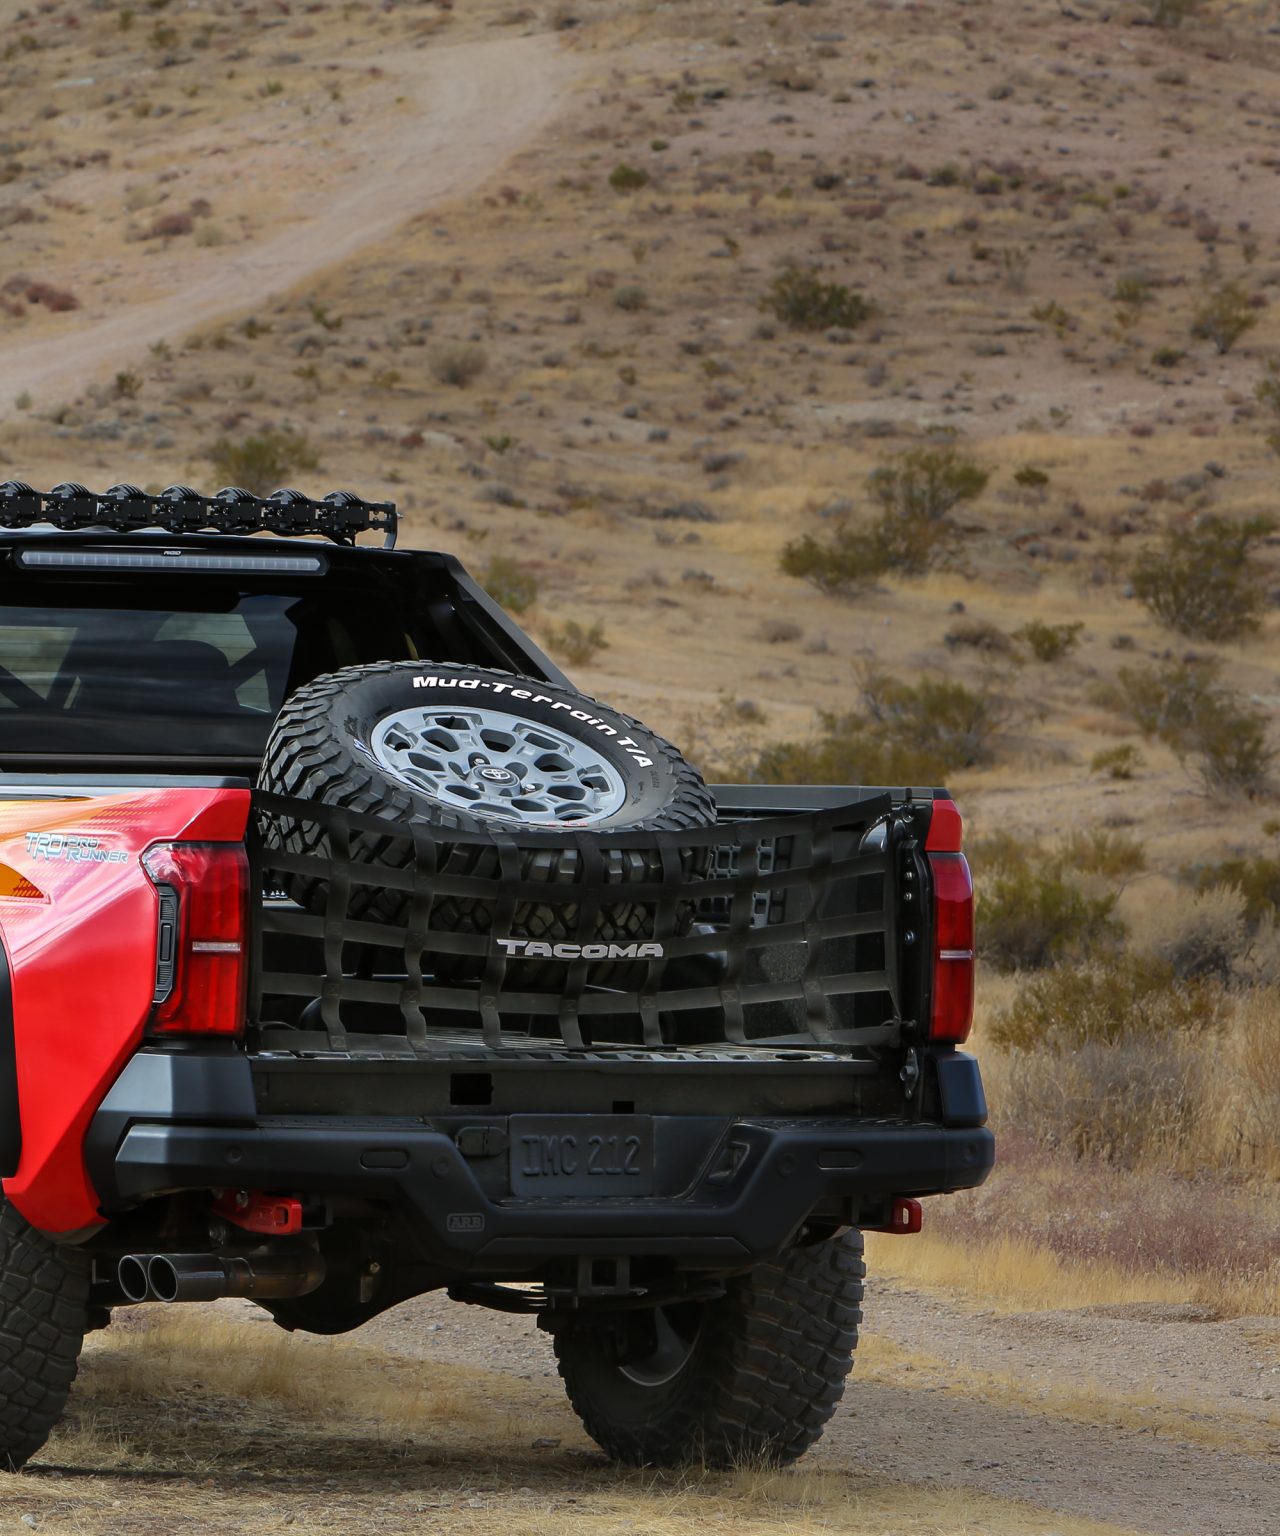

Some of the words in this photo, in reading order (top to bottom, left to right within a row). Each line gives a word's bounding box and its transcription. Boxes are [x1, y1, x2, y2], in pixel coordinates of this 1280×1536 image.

[412, 676, 618, 737] Mud-Terrain
[616, 736, 655, 769] T/A
[24, 832, 64, 861] TRD
[66, 847, 129, 864] RUNNER
[496, 938, 664, 959] TACOMA
[521, 1134, 577, 1177] IMC
[587, 1134, 641, 1177] 212
[450, 1216, 481, 1229] ARB
